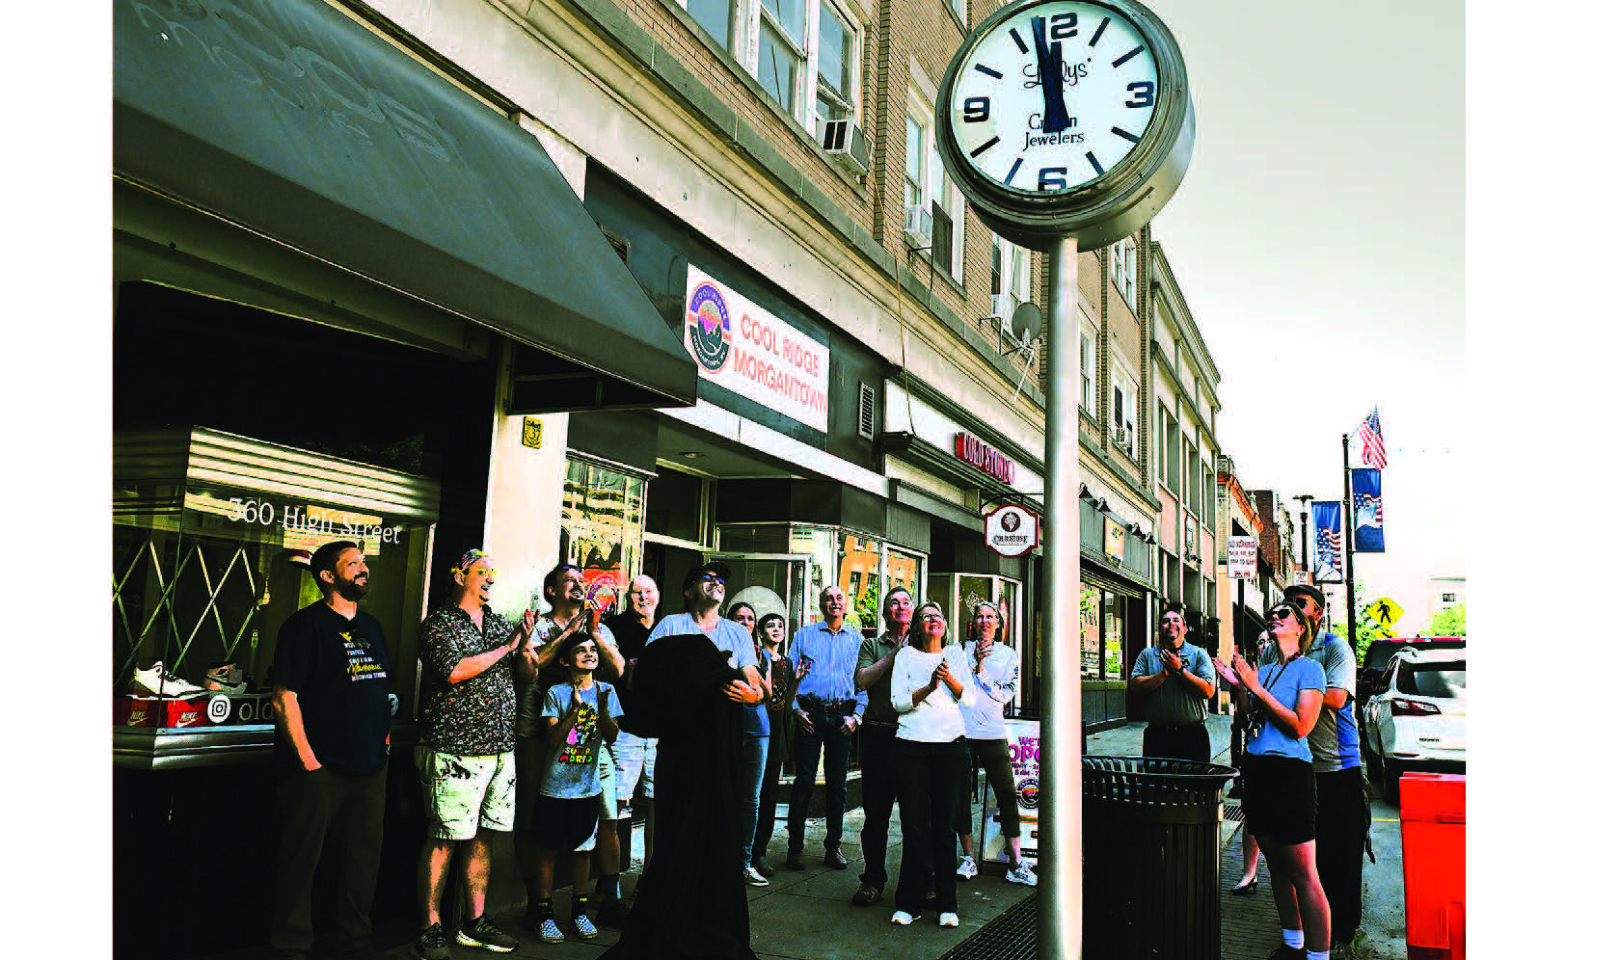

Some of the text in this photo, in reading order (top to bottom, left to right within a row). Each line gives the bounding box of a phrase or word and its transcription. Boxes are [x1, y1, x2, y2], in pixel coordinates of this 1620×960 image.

[1125, 81, 1154, 108] 3
[964, 97, 990, 123] 9
[1022, 131, 1085, 151] Jewelers
[1038, 167, 1067, 191] 6
[740, 313, 818, 378] COOL RIDGE
[734, 346, 826, 413] MORGANTOWN
[227, 497, 401, 544] 360 High Street
[130, 711, 146, 720] NIKE
[181, 711, 198, 720] NIKE
[560, 755, 593, 763] MARIO
[564, 747, 591, 755] SUPER
